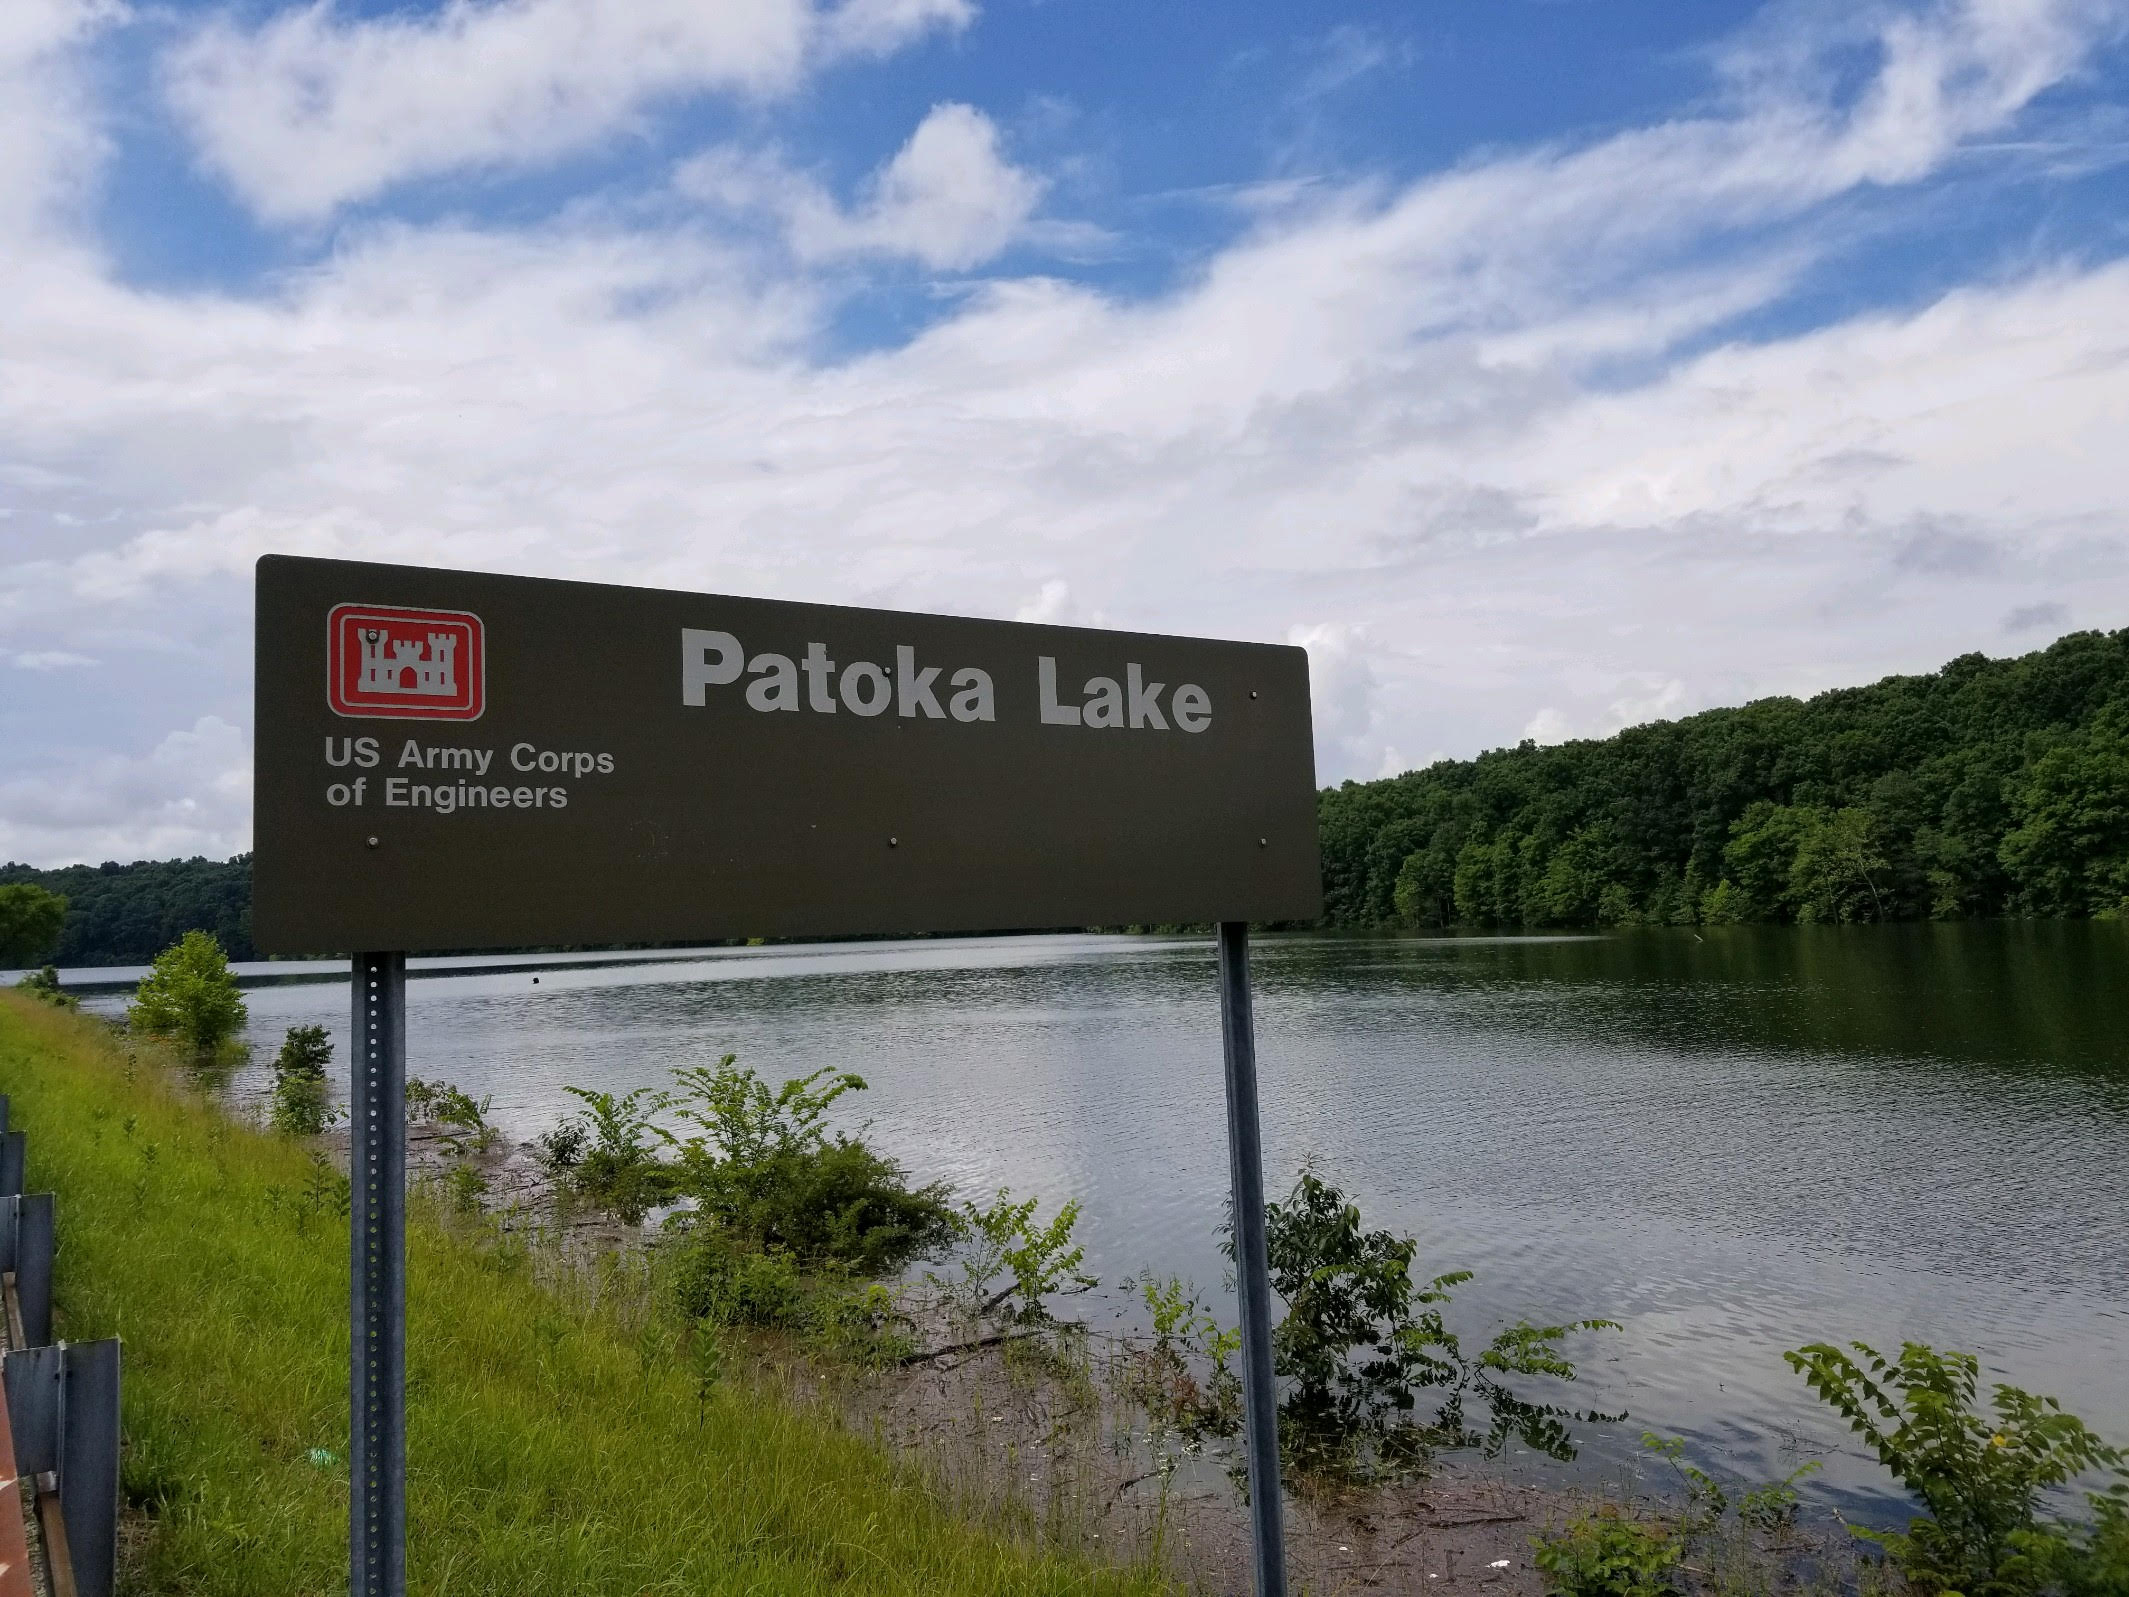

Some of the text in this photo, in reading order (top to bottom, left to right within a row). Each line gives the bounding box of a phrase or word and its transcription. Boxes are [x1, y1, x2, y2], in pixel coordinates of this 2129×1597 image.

[681, 627, 1212, 734] Patoka Lake
[325, 736, 615, 778] US Army Corps
[326, 776, 568, 814] of Engineers
